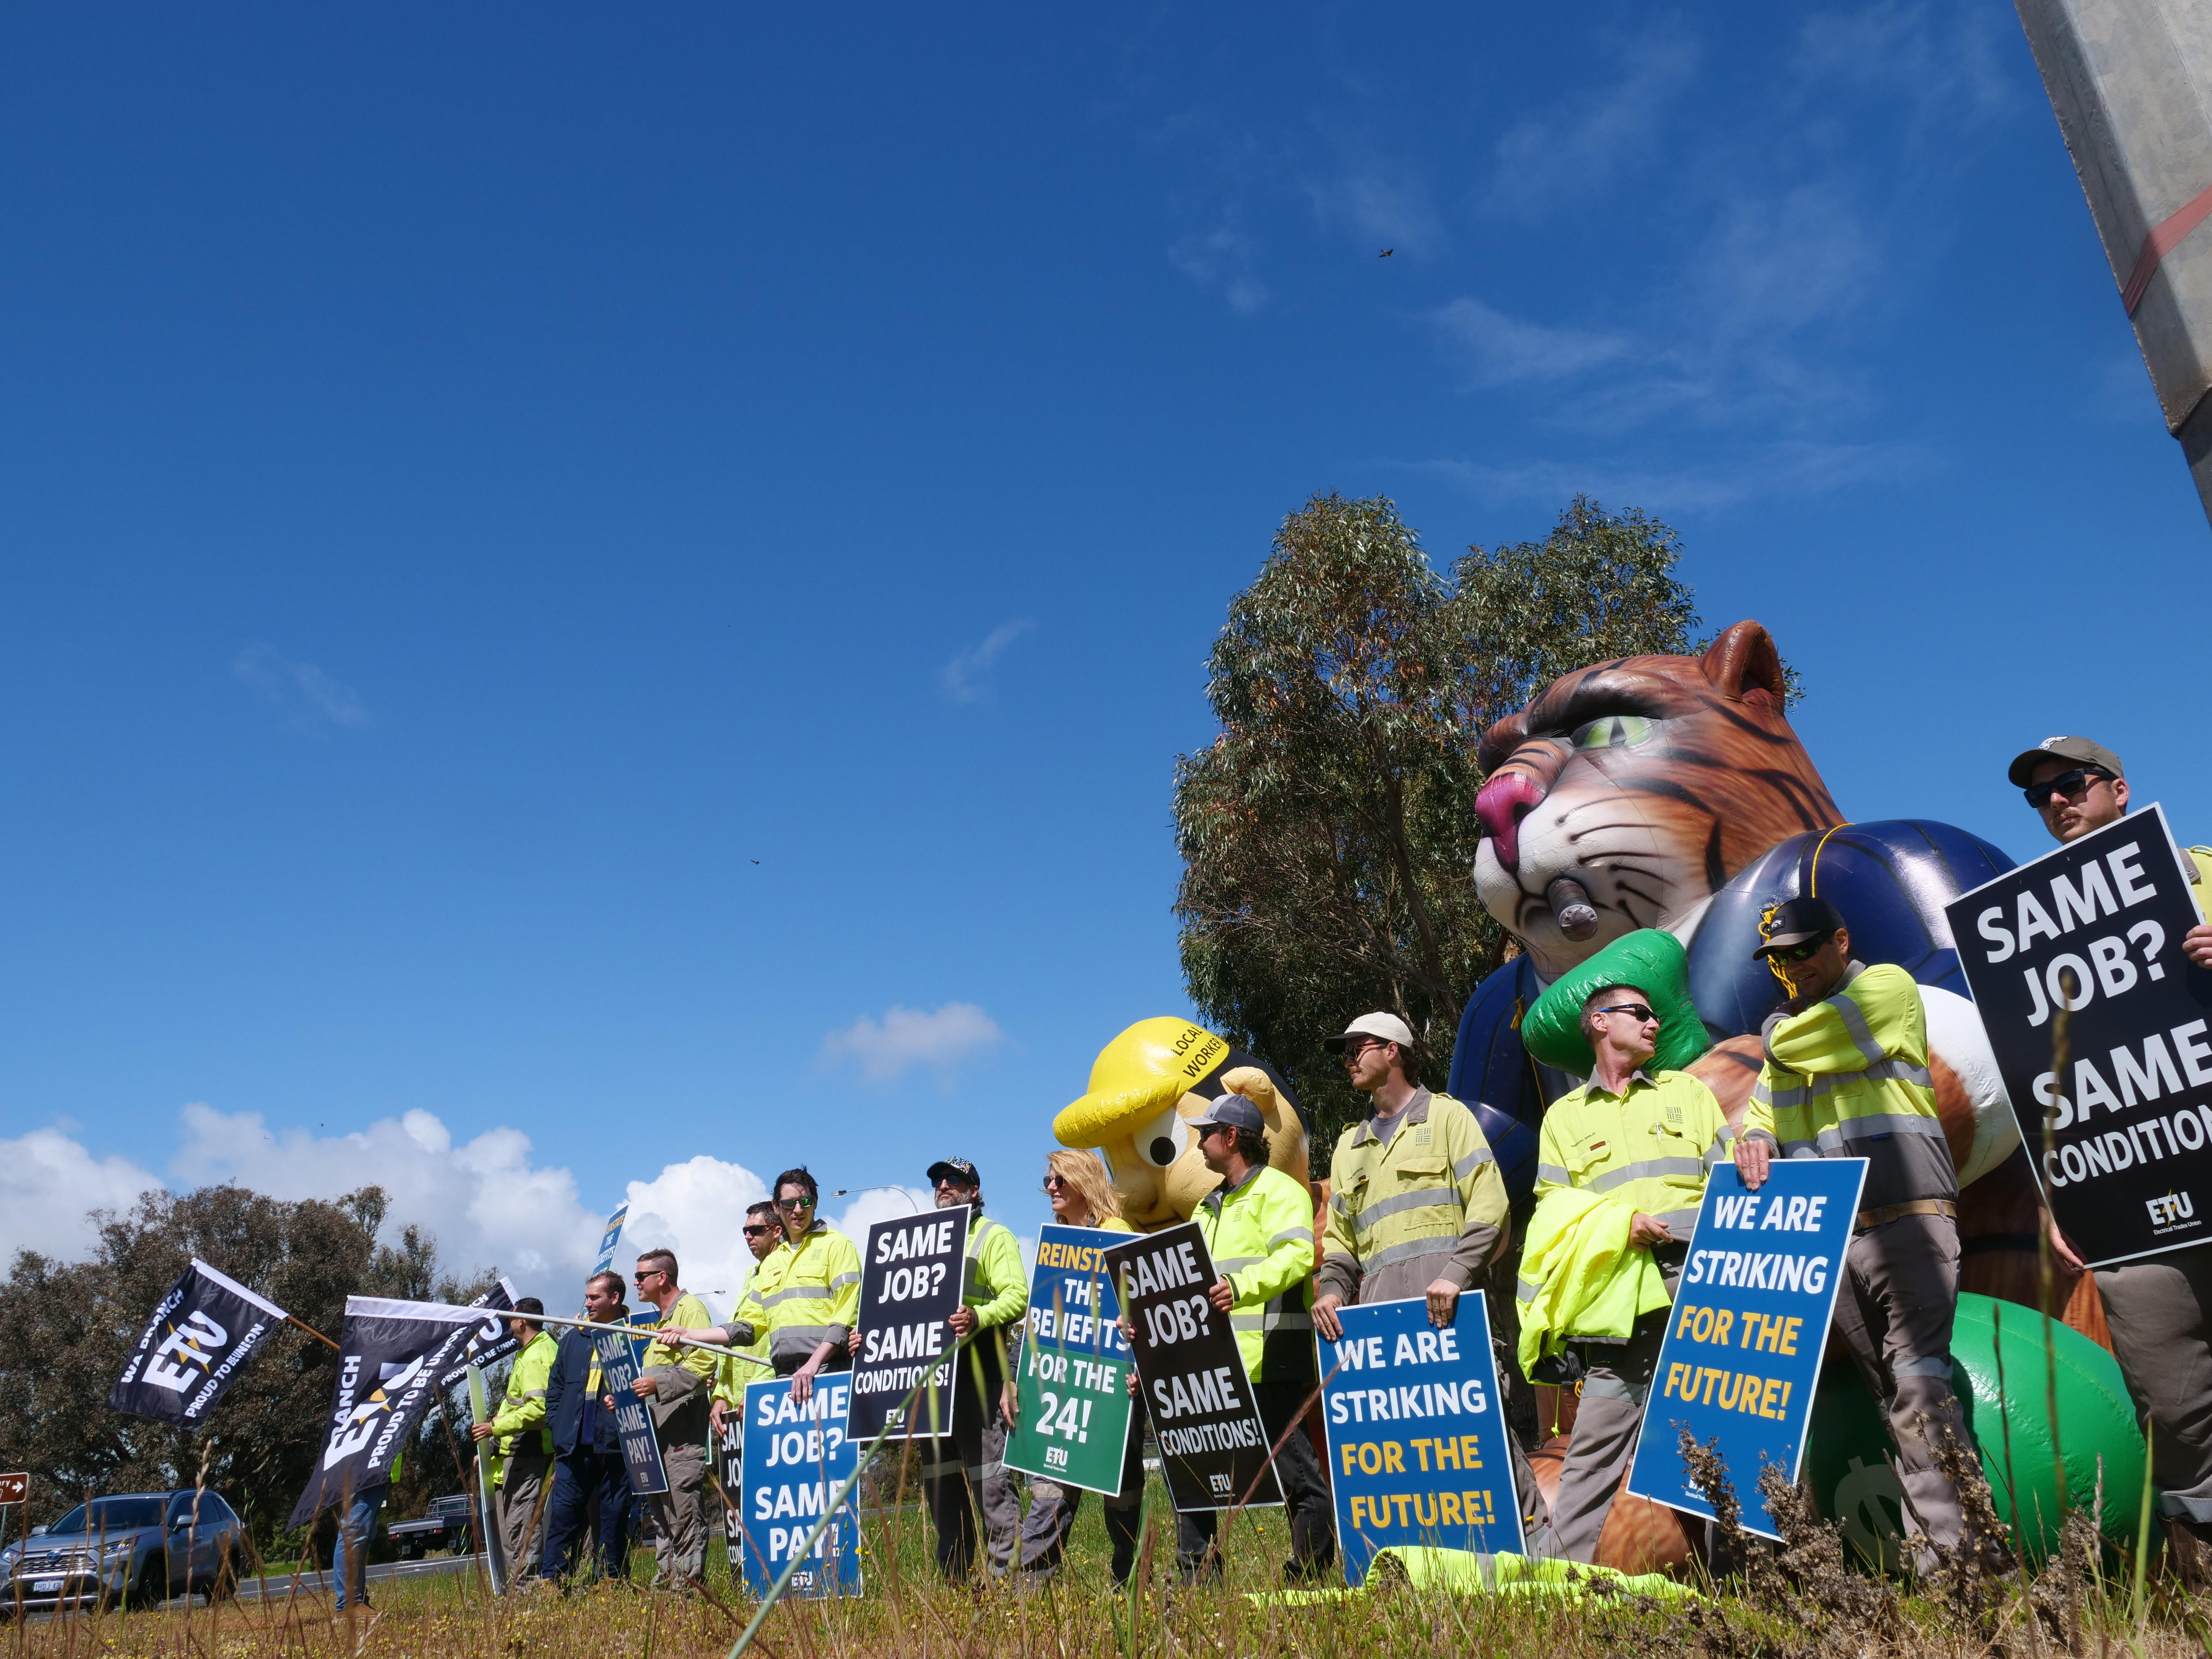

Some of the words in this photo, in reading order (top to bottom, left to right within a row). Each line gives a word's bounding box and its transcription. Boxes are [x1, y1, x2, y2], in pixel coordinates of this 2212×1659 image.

[1977, 841, 2157, 963] SAME
[2024, 920, 2166, 1027] JOB?
[1171, 1026, 1202, 1056] LOCAL
[1183, 1037, 1224, 1078] WORKER
[2032, 1018, 2212, 1130] SAME
[1714, 1196, 1761, 1229] WE
[1760, 1196, 1827, 1232] ARE
[2146, 1191, 2193, 1225] ETU
[875, 1221, 954, 1263] SAME
[2154, 1226, 2173, 1235] Electrical
[879, 1263, 946, 1304] JOB?
[1120, 1241, 1203, 1299] SAME
[1686, 1249, 1828, 1294] STRIKING
[1065, 1279, 1103, 1307] THE
[1144, 1295, 1210, 1347] JOB?
[1676, 1305, 1733, 1345] FOR
[1741, 1312, 1803, 1356] THE
[142, 1311, 227, 1393] ETU
[471, 1356, 484, 1366] TO
[484, 1348, 497, 1359] BE
[497, 1339, 519, 1352] UNIO
[597, 1332, 628, 1363] SAME
[864, 1321, 943, 1363] SAME
[1334, 1336, 1386, 1371] WE
[1394, 1328, 1460, 1366] ARE
[121, 1354, 143, 1383] WA
[608, 1363, 632, 1394] JOB?
[855, 1363, 949, 1394] CONDITIONS!
[1028, 1352, 1068, 1383] FOR
[1073, 1359, 1117, 1394] THE
[184, 1379, 218, 1418] PROUD
[213, 1364, 231, 1379] TO
[367, 1411, 404, 1469] PROUD
[396, 1390, 419, 1409] TO
[411, 1369, 433, 1387] BE
[425, 1326, 467, 1367] UNION
[757, 1386, 848, 1426] SAME
[1154, 1366, 1241, 1418] SAME
[1331, 1379, 1487, 1424] STRIKING
[1664, 1362, 1792, 1421] FUTURE!
[615, 1403, 647, 1433] SAME
[1036, 1392, 1092, 1444] 24!
[1161, 1418, 1262, 1456] CONDITIONS!
[626, 1436, 652, 1464] PAY!
[766, 1427, 843, 1467] JOB?
[1046, 1446, 1068, 1466] ETU
[1341, 1441, 1406, 1475] FOR
[1410, 1435, 1483, 1471] THE
[640, 1472, 649, 1483] ETU
[1209, 1474, 1231, 1492] ETU
[755, 1480, 846, 1520] SAME
[1351, 1490, 1495, 1528] FUTURE!
[770, 1523, 840, 1562] PAY!
